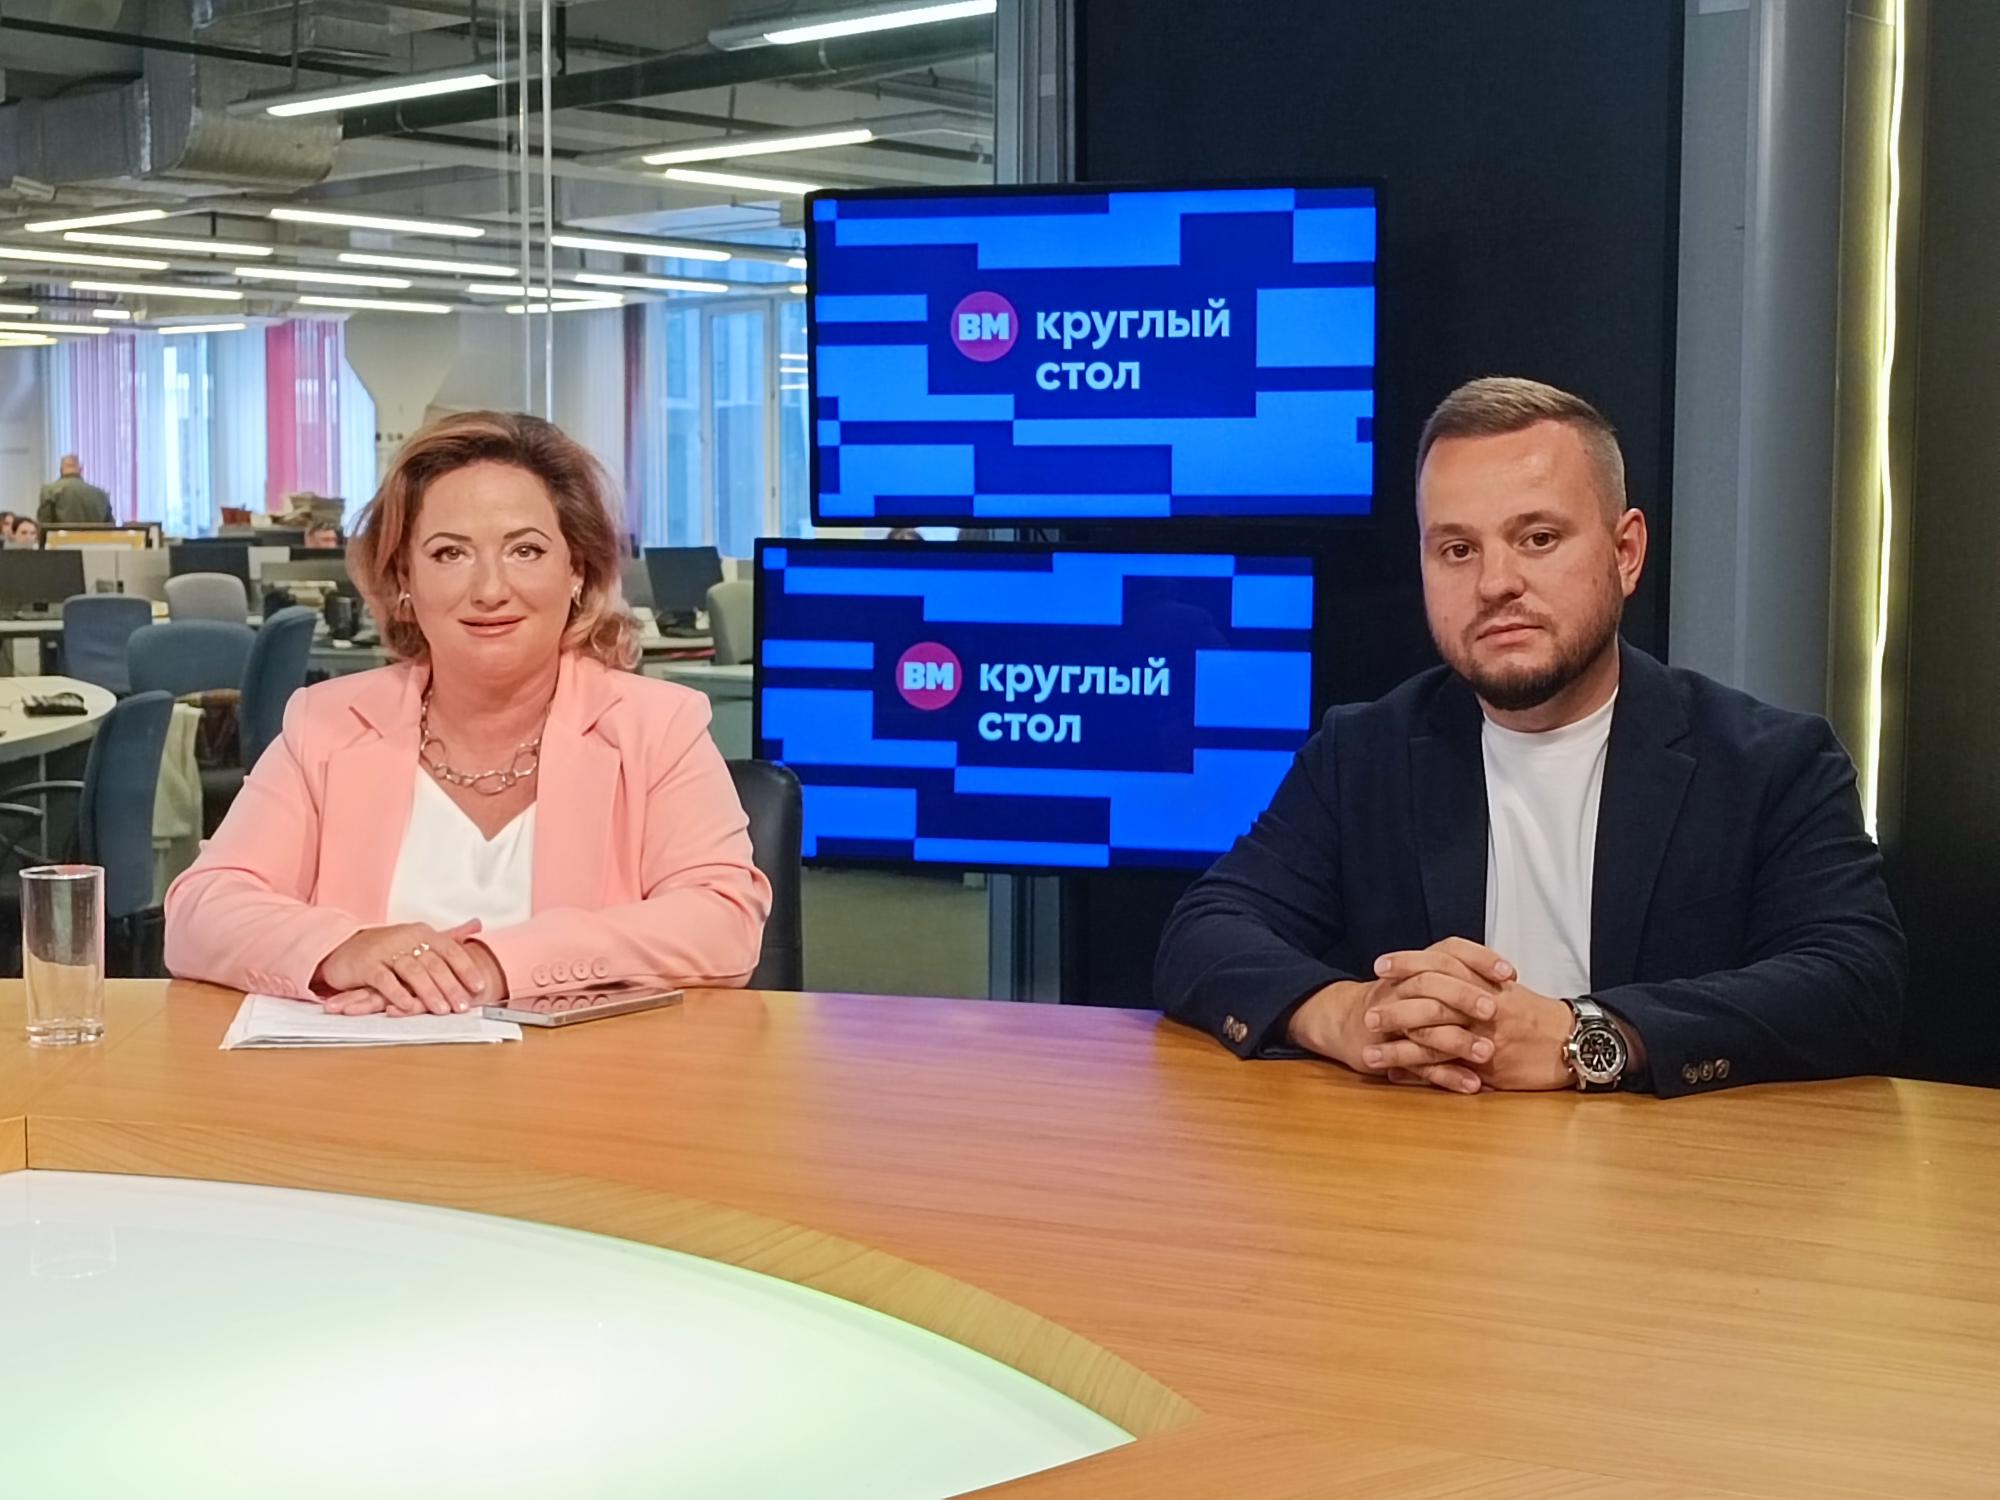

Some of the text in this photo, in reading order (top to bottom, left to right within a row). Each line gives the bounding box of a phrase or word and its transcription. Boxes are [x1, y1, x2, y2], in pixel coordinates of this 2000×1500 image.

[958, 312, 1010, 341] ВМ
[1036, 298, 1230, 349] круглый
[1035, 362, 1140, 390] стол
[903, 661, 954, 691] ВМ
[979, 657, 1170, 702] круглый
[978, 712, 1081, 742] стол
